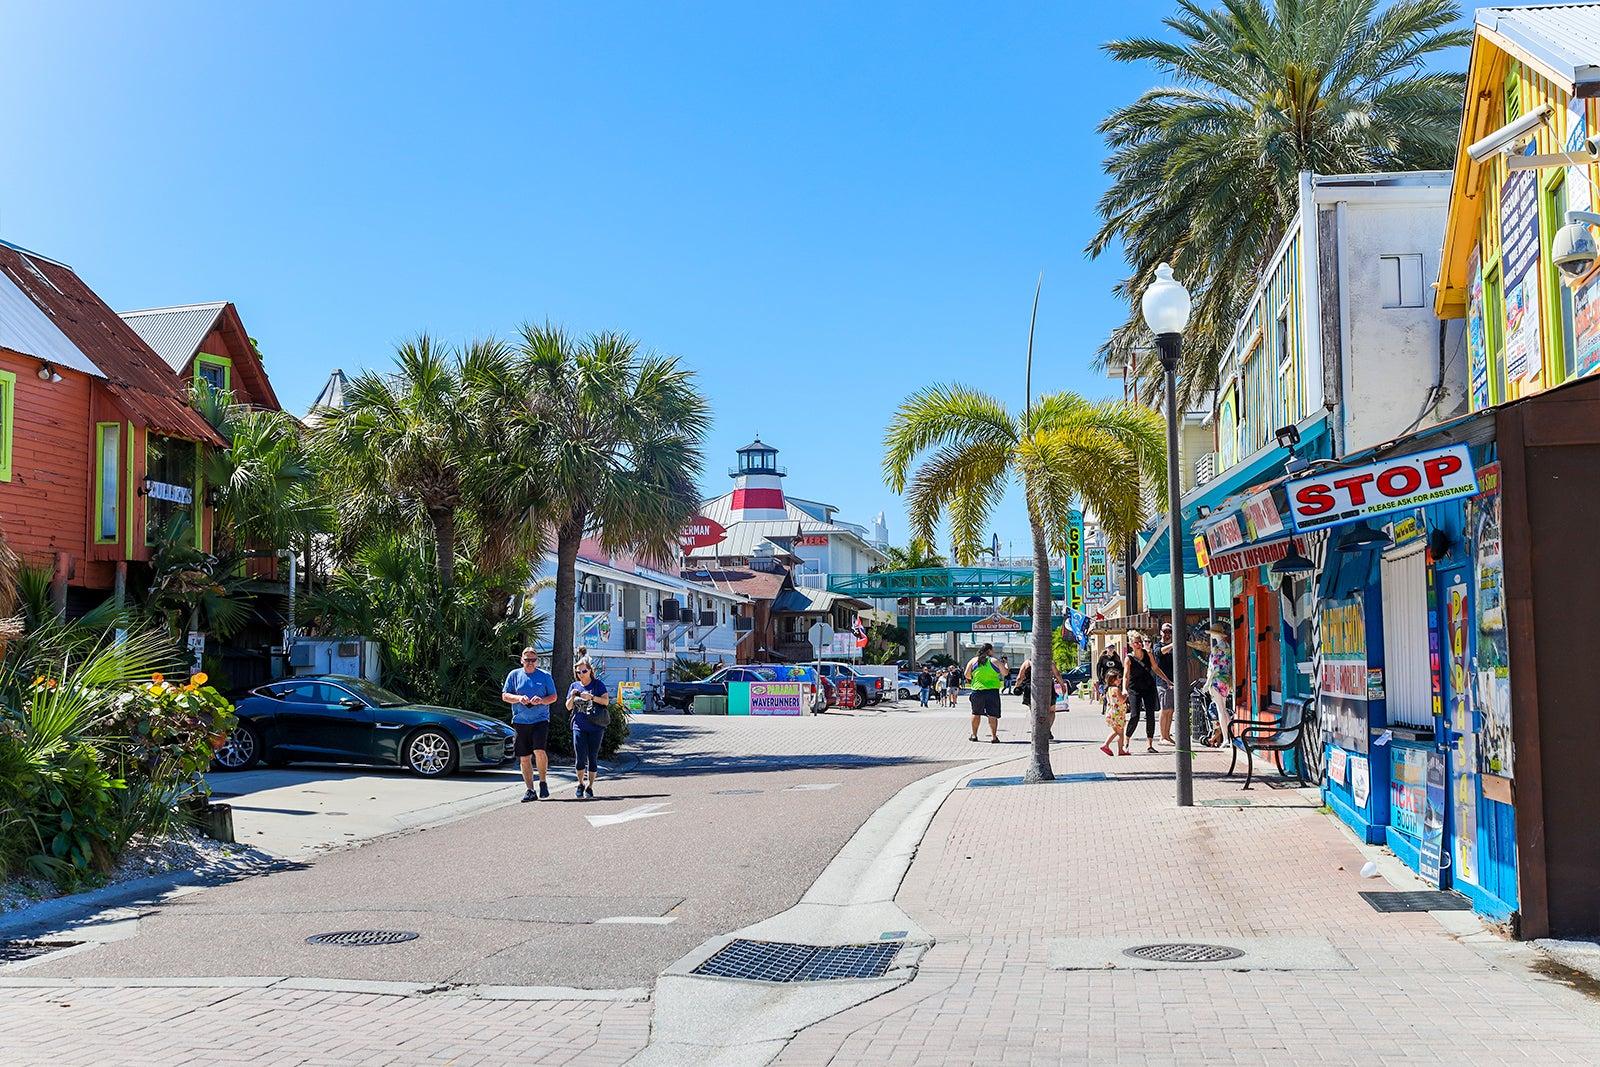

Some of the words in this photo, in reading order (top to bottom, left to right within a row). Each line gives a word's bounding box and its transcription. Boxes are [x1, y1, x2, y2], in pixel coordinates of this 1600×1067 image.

[1296, 455, 1463, 516] STOP
[1368, 501, 1396, 513] PLEASE
[1397, 497, 1412, 507] ASK
[1413, 493, 1428, 504] FOR
[1429, 483, 1475, 500] ASSISTANCE
[1244, 537, 1306, 567] INFORMATON
[1069, 527, 1081, 611] GRILLE
[752, 697, 800, 707] WAVERUNNERS
[1451, 590, 1471, 878] PARASAIL
[1391, 782, 1425, 815] TICKET
[1397, 809, 1419, 831] BOOTH
